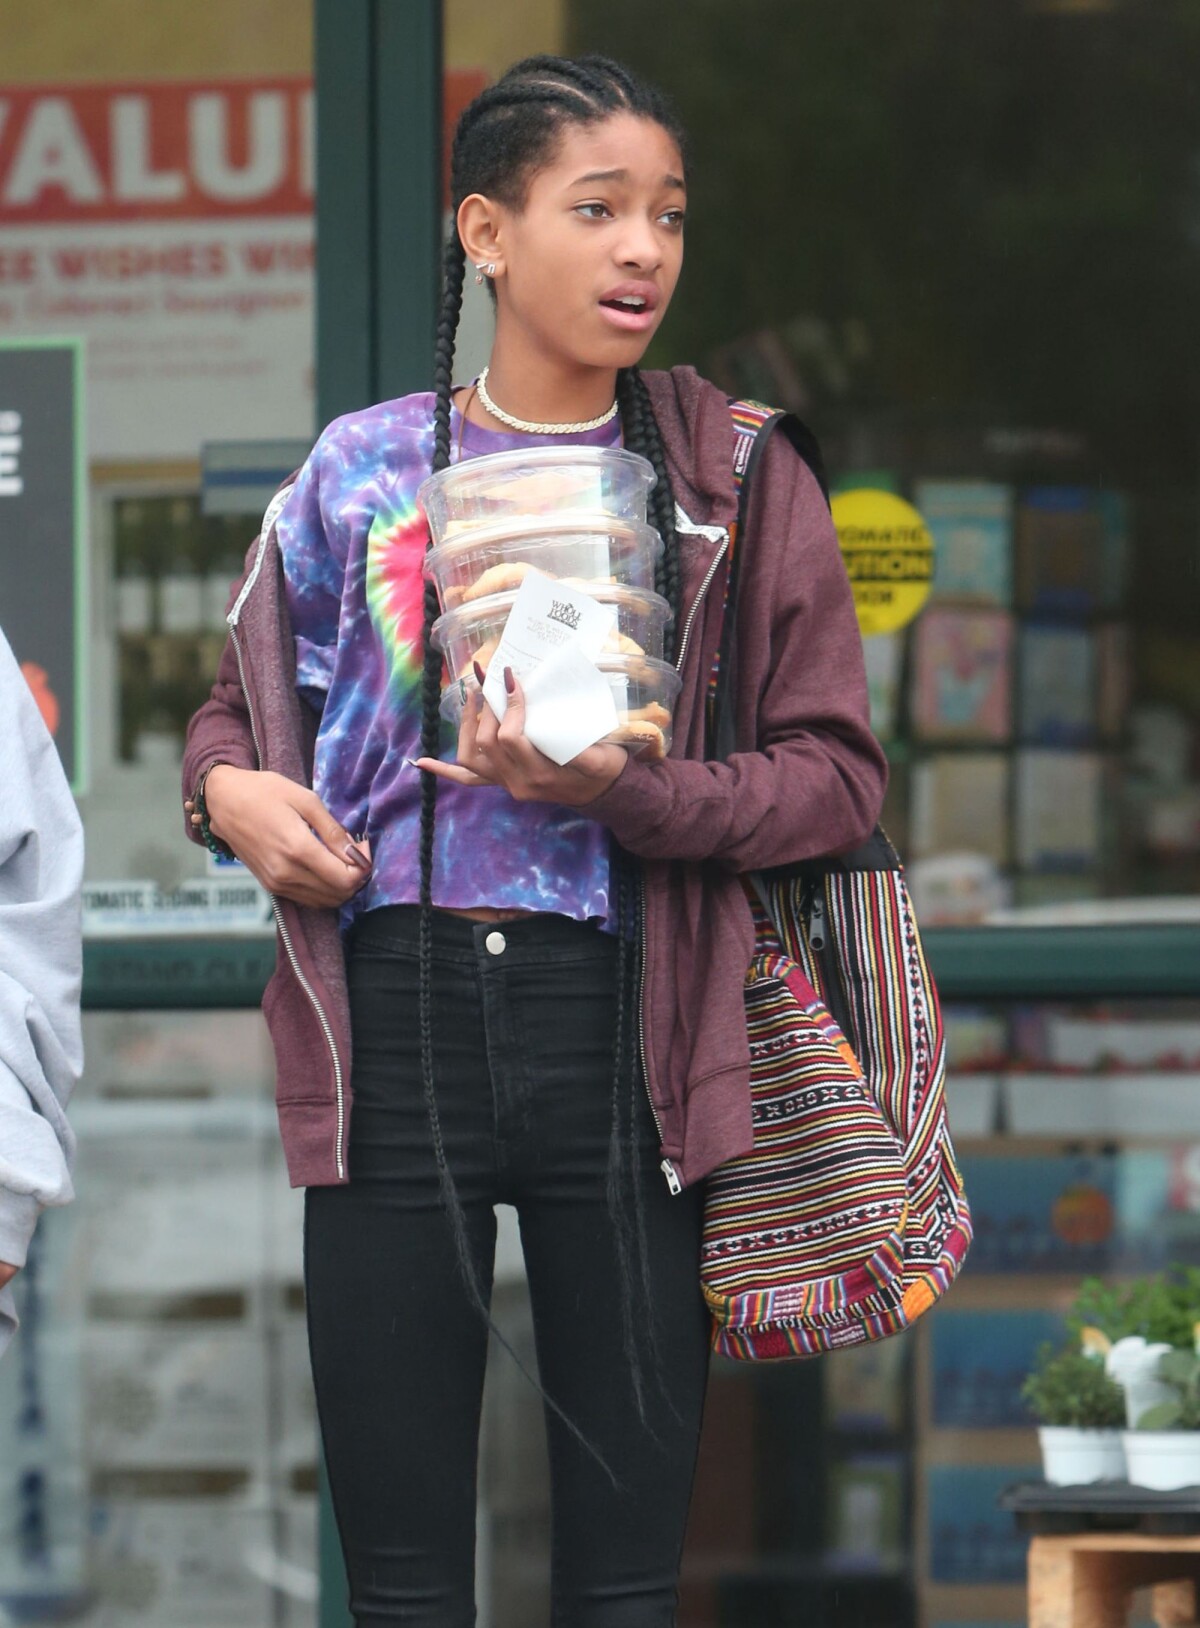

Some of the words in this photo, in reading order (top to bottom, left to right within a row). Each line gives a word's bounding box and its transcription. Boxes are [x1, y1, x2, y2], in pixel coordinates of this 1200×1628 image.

[0, 90, 314, 204] ALU
[841, 550, 929, 579] UTION
[548, 607, 578, 627] FOODS
[83, 889, 144, 909] TOMATIC
